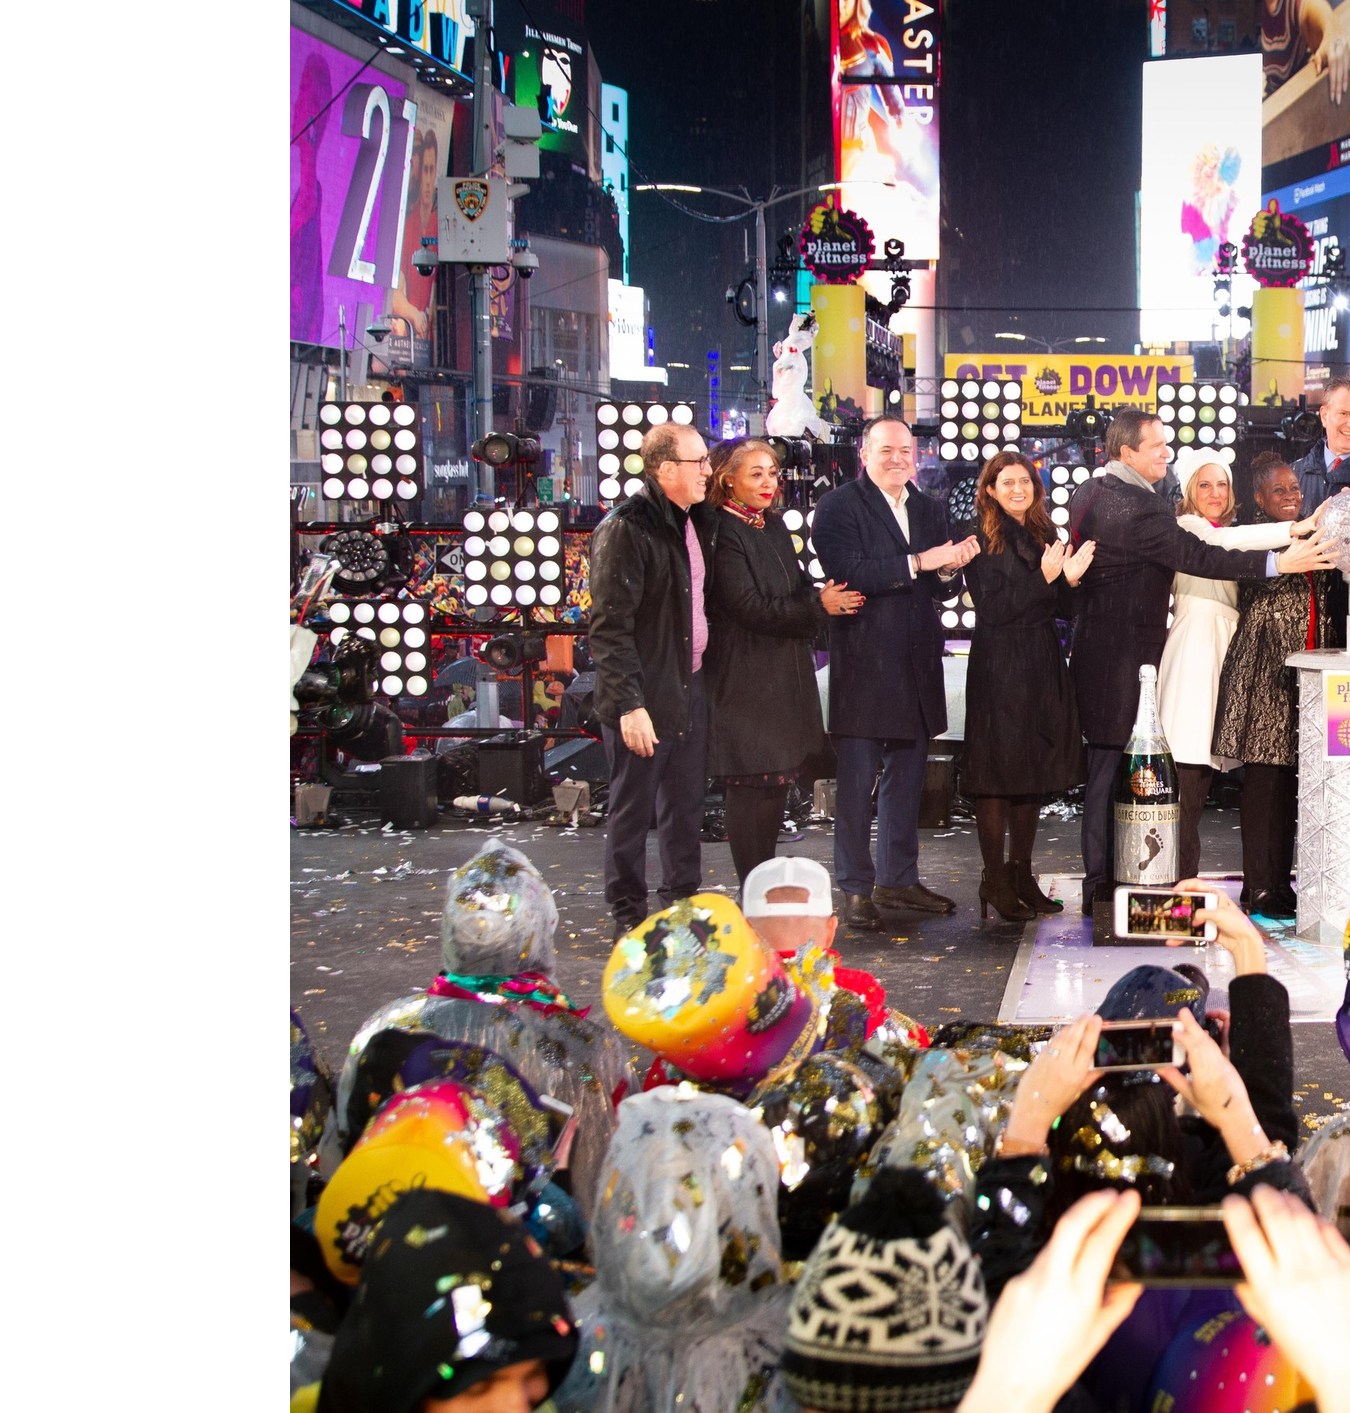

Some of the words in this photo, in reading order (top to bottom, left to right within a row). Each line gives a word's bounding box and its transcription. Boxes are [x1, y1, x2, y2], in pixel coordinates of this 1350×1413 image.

[347, 84, 417, 289] 21
[807, 239, 857, 255] planet
[1248, 243, 1297, 260] planet
[814, 251, 867, 264] fitness
[1255, 255, 1307, 270] fitness
[434, 459, 459, 483] sunglass
[1146, 787, 1174, 796] SQUARE
[1118, 809, 1156, 821] BAREFOOT
